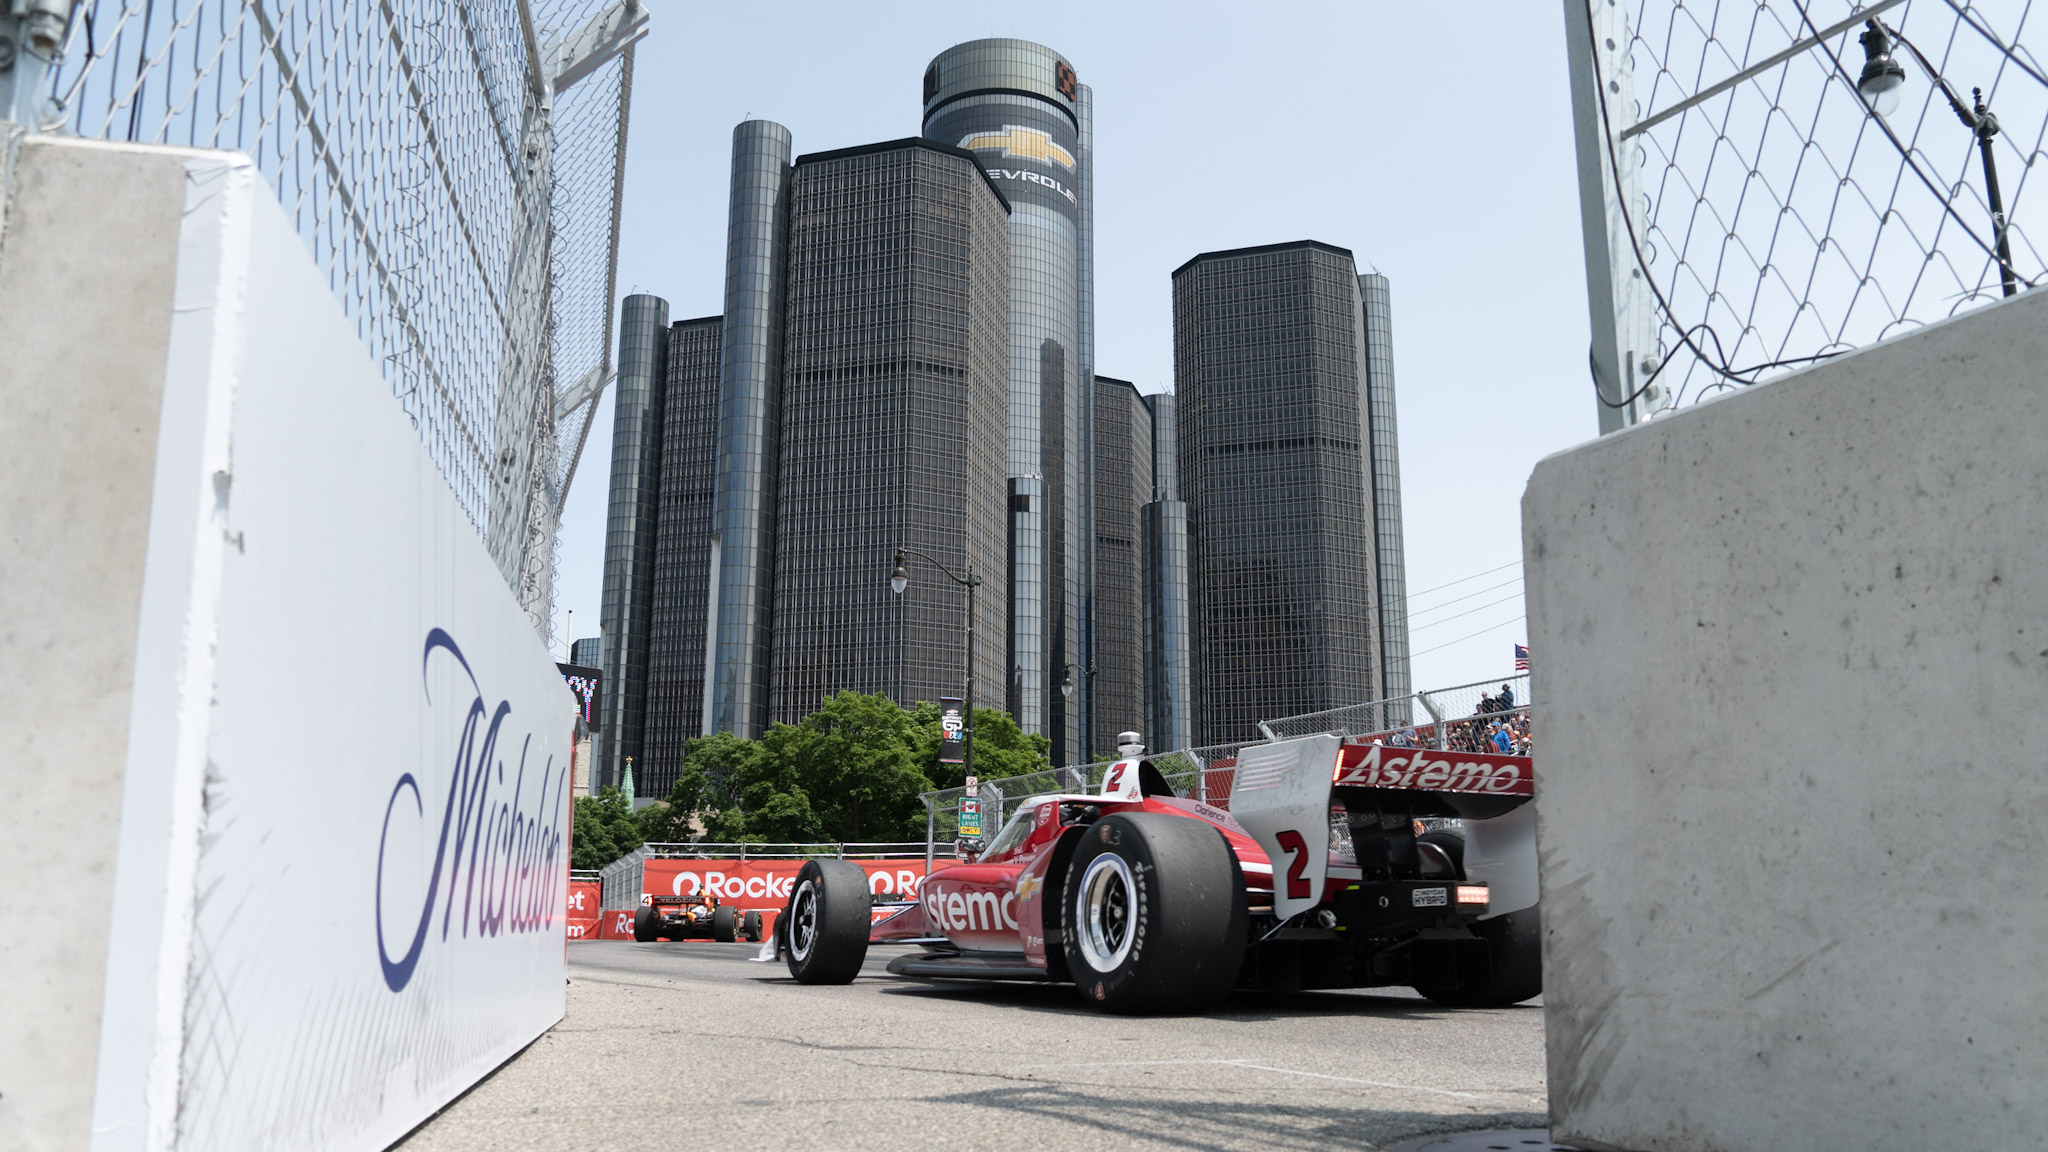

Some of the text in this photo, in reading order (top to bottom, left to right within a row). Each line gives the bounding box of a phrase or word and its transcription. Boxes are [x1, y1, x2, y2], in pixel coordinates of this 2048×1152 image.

[986, 169, 1077, 207] EVROLE
[942, 720, 963, 732] GP
[1106, 763, 1127, 792] 2
[1337, 746, 1520, 791] Astemo
[376, 628, 566, 993] Michelob
[1195, 803, 1225, 822] Clarience
[1275, 829, 1311, 900] 2
[1132, 861, 1148, 962] Firestone
[1414, 896, 1446, 904] HYBRID
